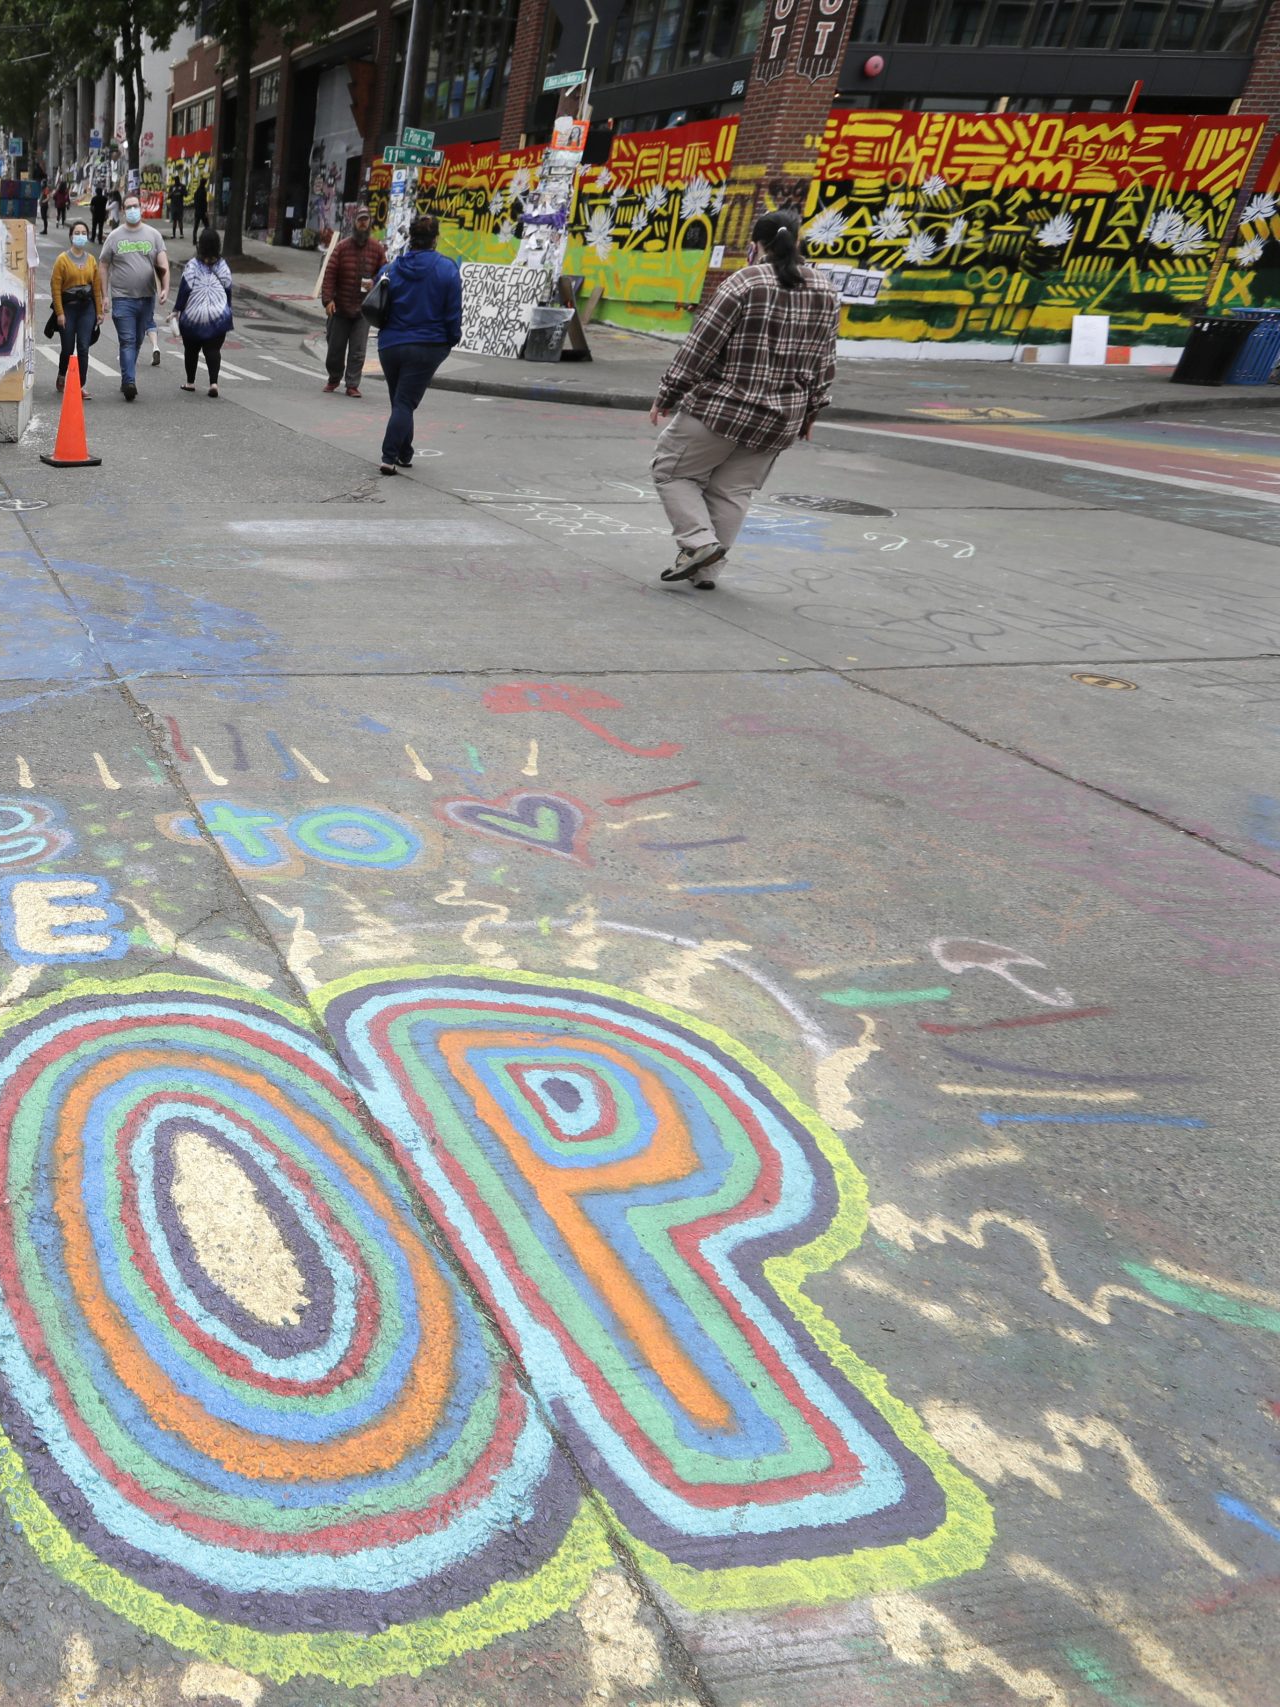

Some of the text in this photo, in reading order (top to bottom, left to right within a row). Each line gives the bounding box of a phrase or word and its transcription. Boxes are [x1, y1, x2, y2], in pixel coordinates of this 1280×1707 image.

[462, 264, 511, 282] GEORGE
[465, 326, 515, 345] GARNER
[481, 341, 520, 359] BROWN
